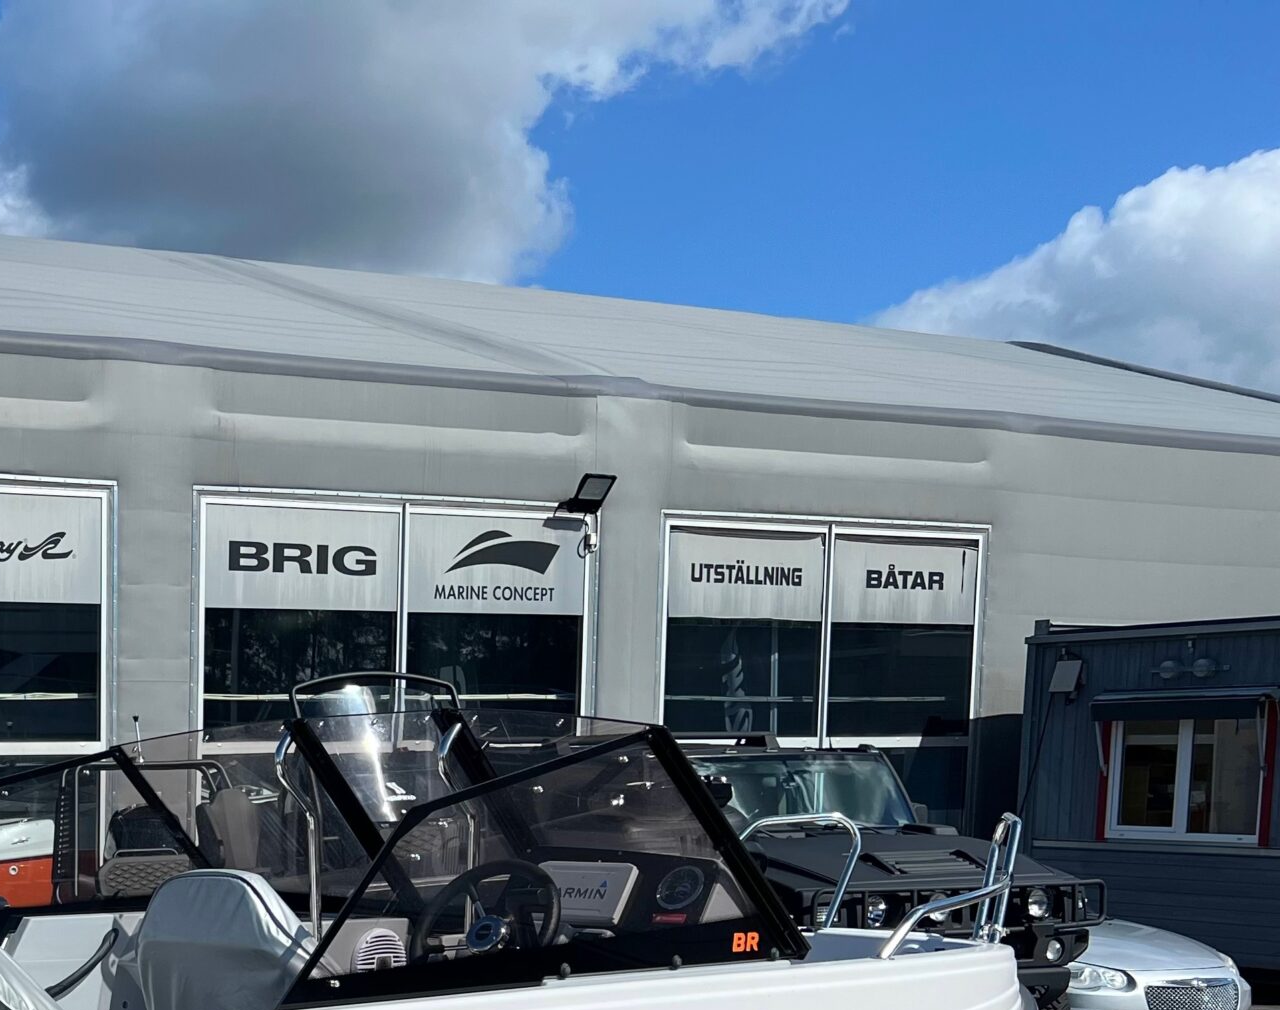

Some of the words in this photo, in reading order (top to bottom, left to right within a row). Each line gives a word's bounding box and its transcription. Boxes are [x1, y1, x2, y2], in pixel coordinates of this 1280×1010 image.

[228, 540, 377, 577] BRIG
[691, 559, 803, 587] UTSTÄLLNING
[865, 563, 945, 591] BÅTAR
[434, 584, 488, 601] MARINE
[493, 585, 555, 602] CONCEPT
[558, 886, 607, 900] ARMIN
[732, 931, 759, 953] BR
